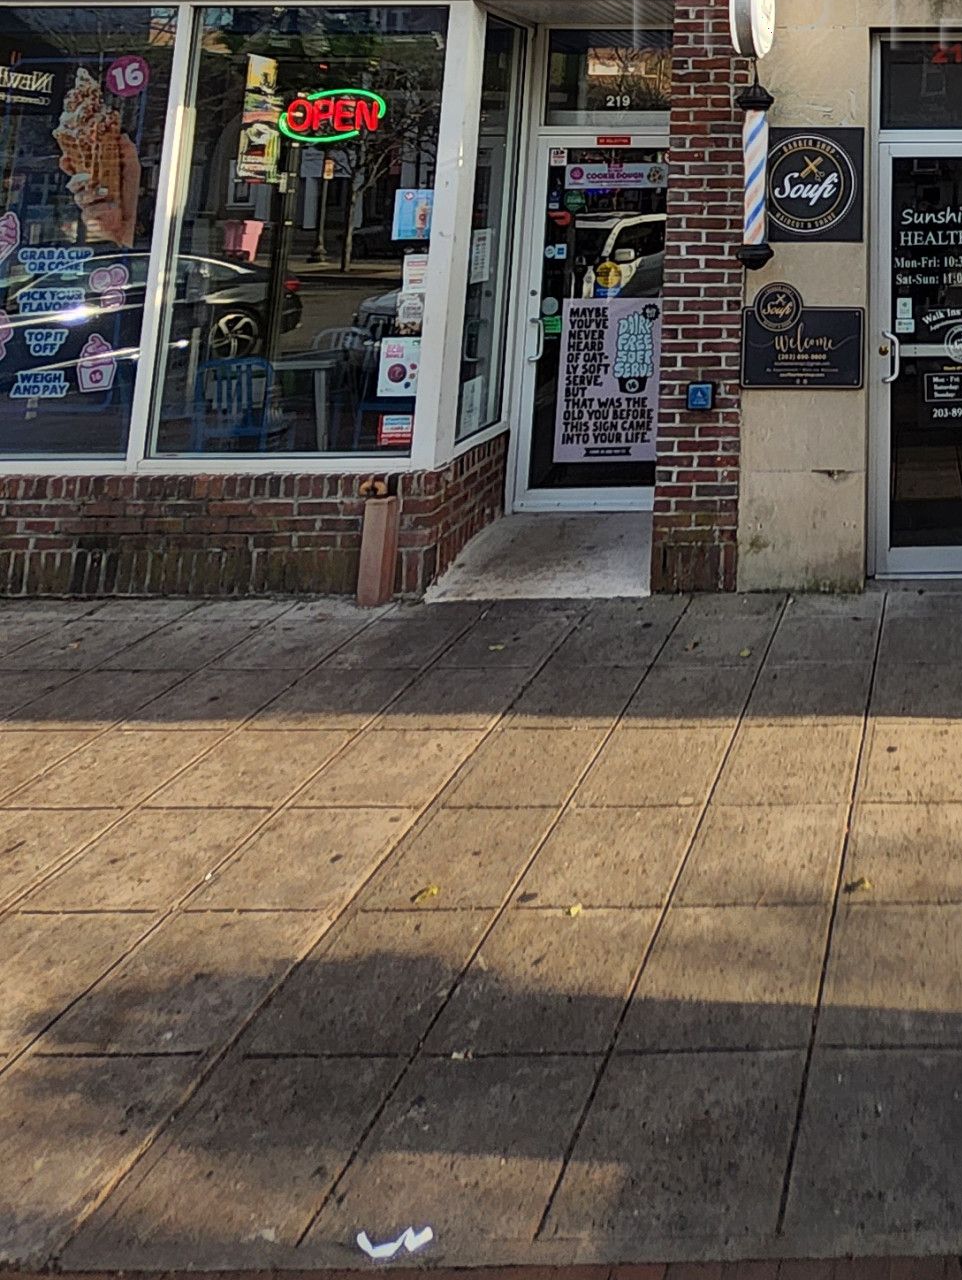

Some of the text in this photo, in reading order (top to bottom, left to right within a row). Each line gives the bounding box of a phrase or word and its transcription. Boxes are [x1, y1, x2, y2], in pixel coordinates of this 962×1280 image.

[111, 62, 144, 91] 16
[606, 95, 631, 107] 219
[287, 98, 379, 132] OPEN
[774, 171, 839, 207] Soufi
[20, 249, 92, 261] GRAB A CUP
[28, 261, 46, 272] OR
[894, 257, 940, 268] Mon-Fri:
[896, 273, 939, 285] Sat-Sun:
[19, 290, 48, 301] PICK
[569, 307, 609, 318] MAYBE
[922, 310, 945, 325] Walk
[947, 308, 961, 318] Ins
[569, 319, 609, 330] YOU'VE
[26, 331, 66, 341] TOP IT
[569, 330, 605, 341] NEVER
[774, 322, 835, 353] Welcome
[32, 343, 59, 354] OFF
[568, 341, 603, 352] HEARD
[617, 334, 653, 351] FREE
[567, 352, 609, 363] OF OAT-
[566, 364, 610, 375] LY SOFT
[614, 363, 653, 378] SERVE
[19, 373, 62, 384] WEIGH
[566, 375, 603, 387] SERVE,
[13, 384, 68, 395] AND PAY
[565, 387, 587, 398] BUT
[564, 397, 648, 409] THAT WAS THE
[563, 408, 654, 420] OLD YOU BEFORE
[563, 420, 652, 433] THIS SIGN CAME
[562, 432, 651, 444] INTO YOUR LIFE.
